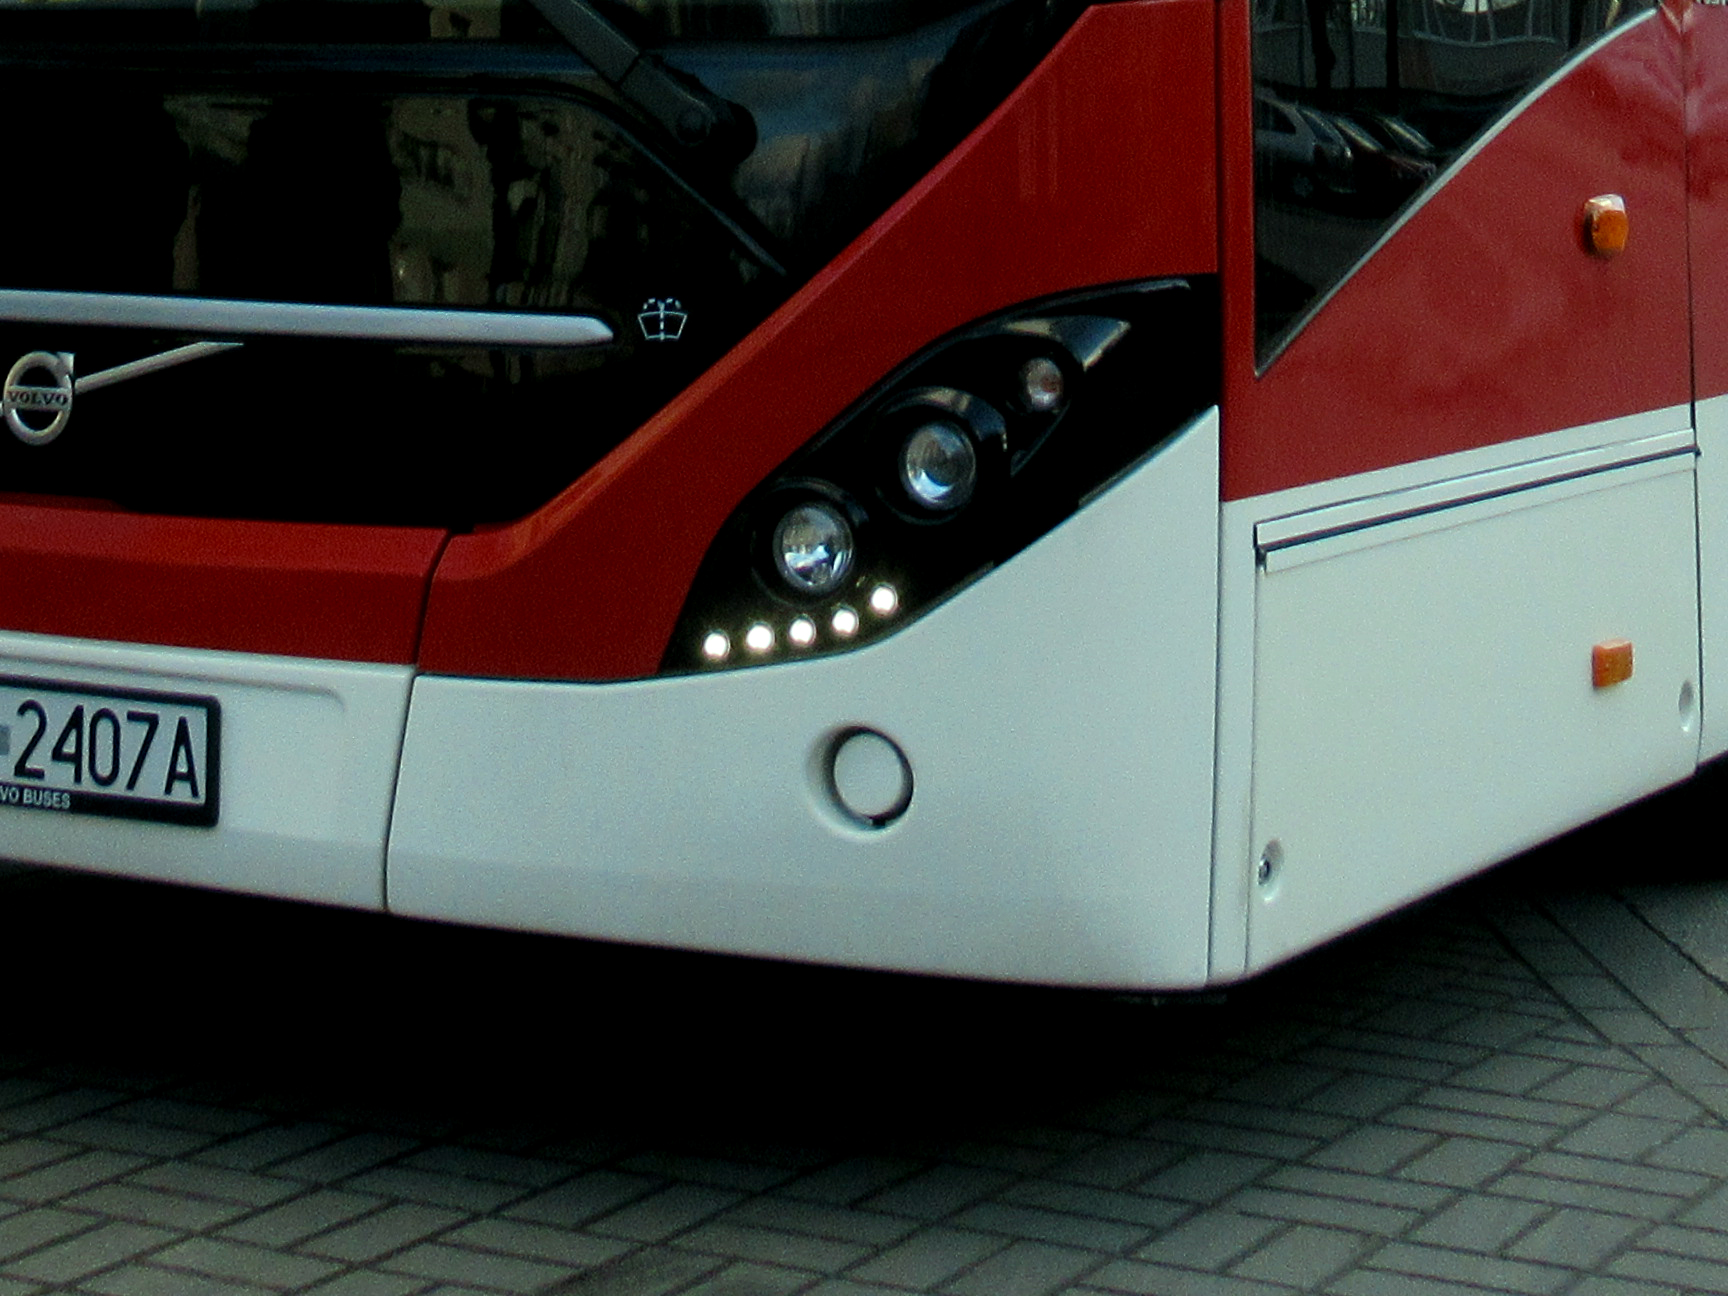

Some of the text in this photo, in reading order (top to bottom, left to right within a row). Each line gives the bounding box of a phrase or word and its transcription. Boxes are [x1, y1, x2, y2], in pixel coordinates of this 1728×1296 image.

[8, 390, 69, 406] VOLVO
[13, 698, 200, 799] 2407A
[22, 788, 72, 809] BUSES
